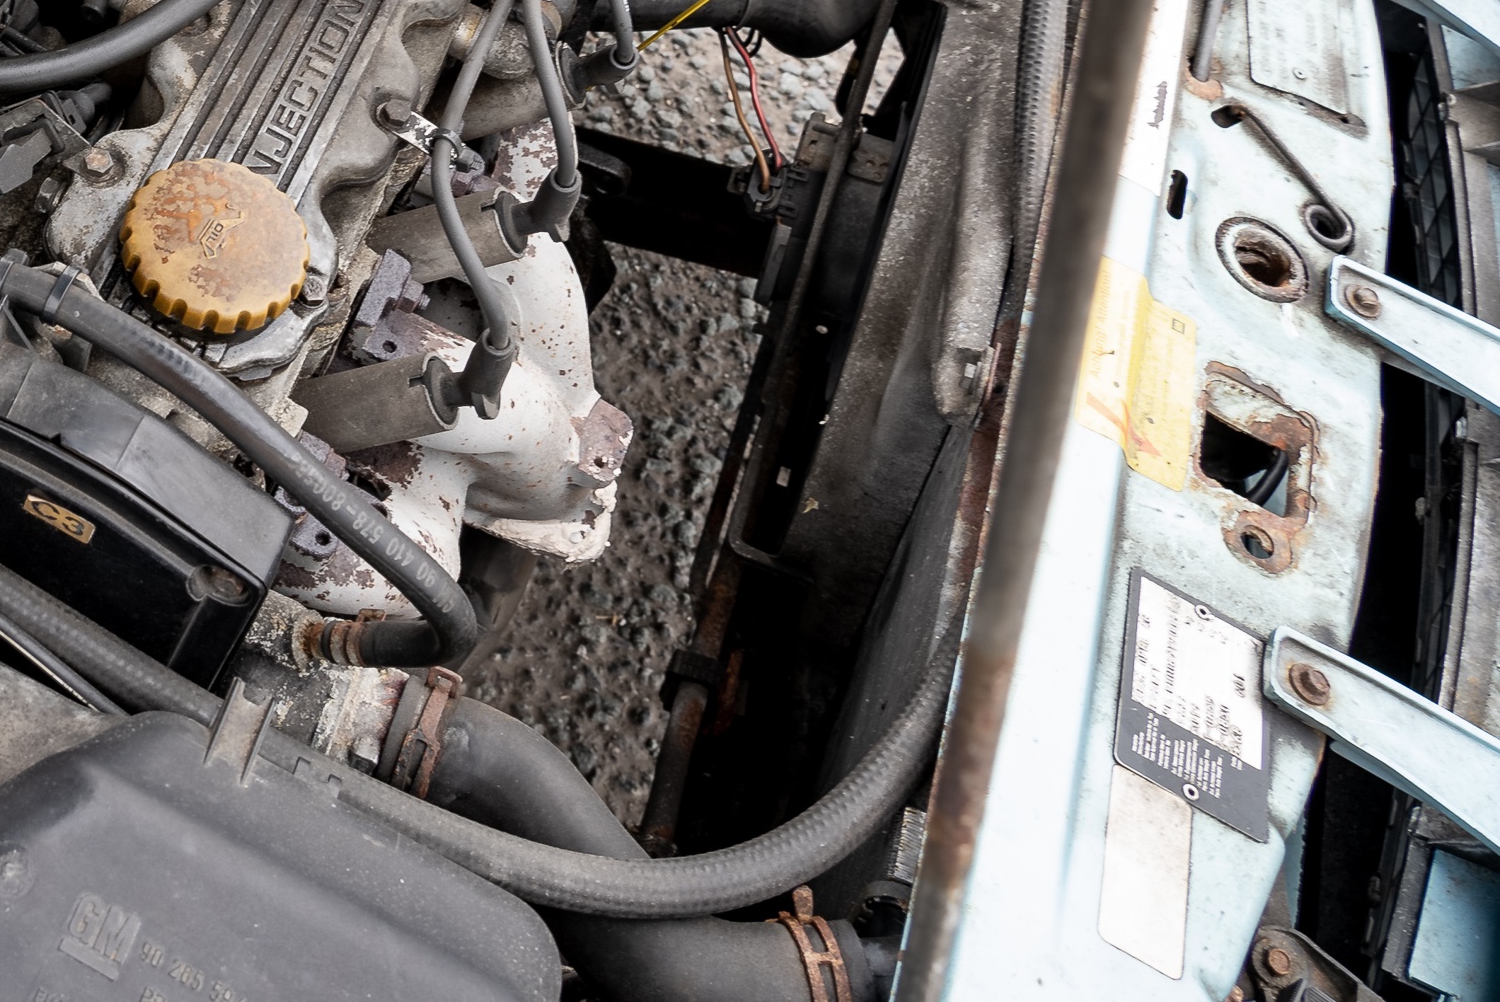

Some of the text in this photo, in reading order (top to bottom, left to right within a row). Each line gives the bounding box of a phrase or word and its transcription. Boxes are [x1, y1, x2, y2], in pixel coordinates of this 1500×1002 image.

[206, 223, 225, 244] OIL
[31, 500, 85, 536] C3
[385, 537, 415, 567] 410
[415, 561, 436, 587] 90
[67, 892, 142, 966] GM
[140, 942, 165, 968] 90
[168, 958, 204, 991] 265
